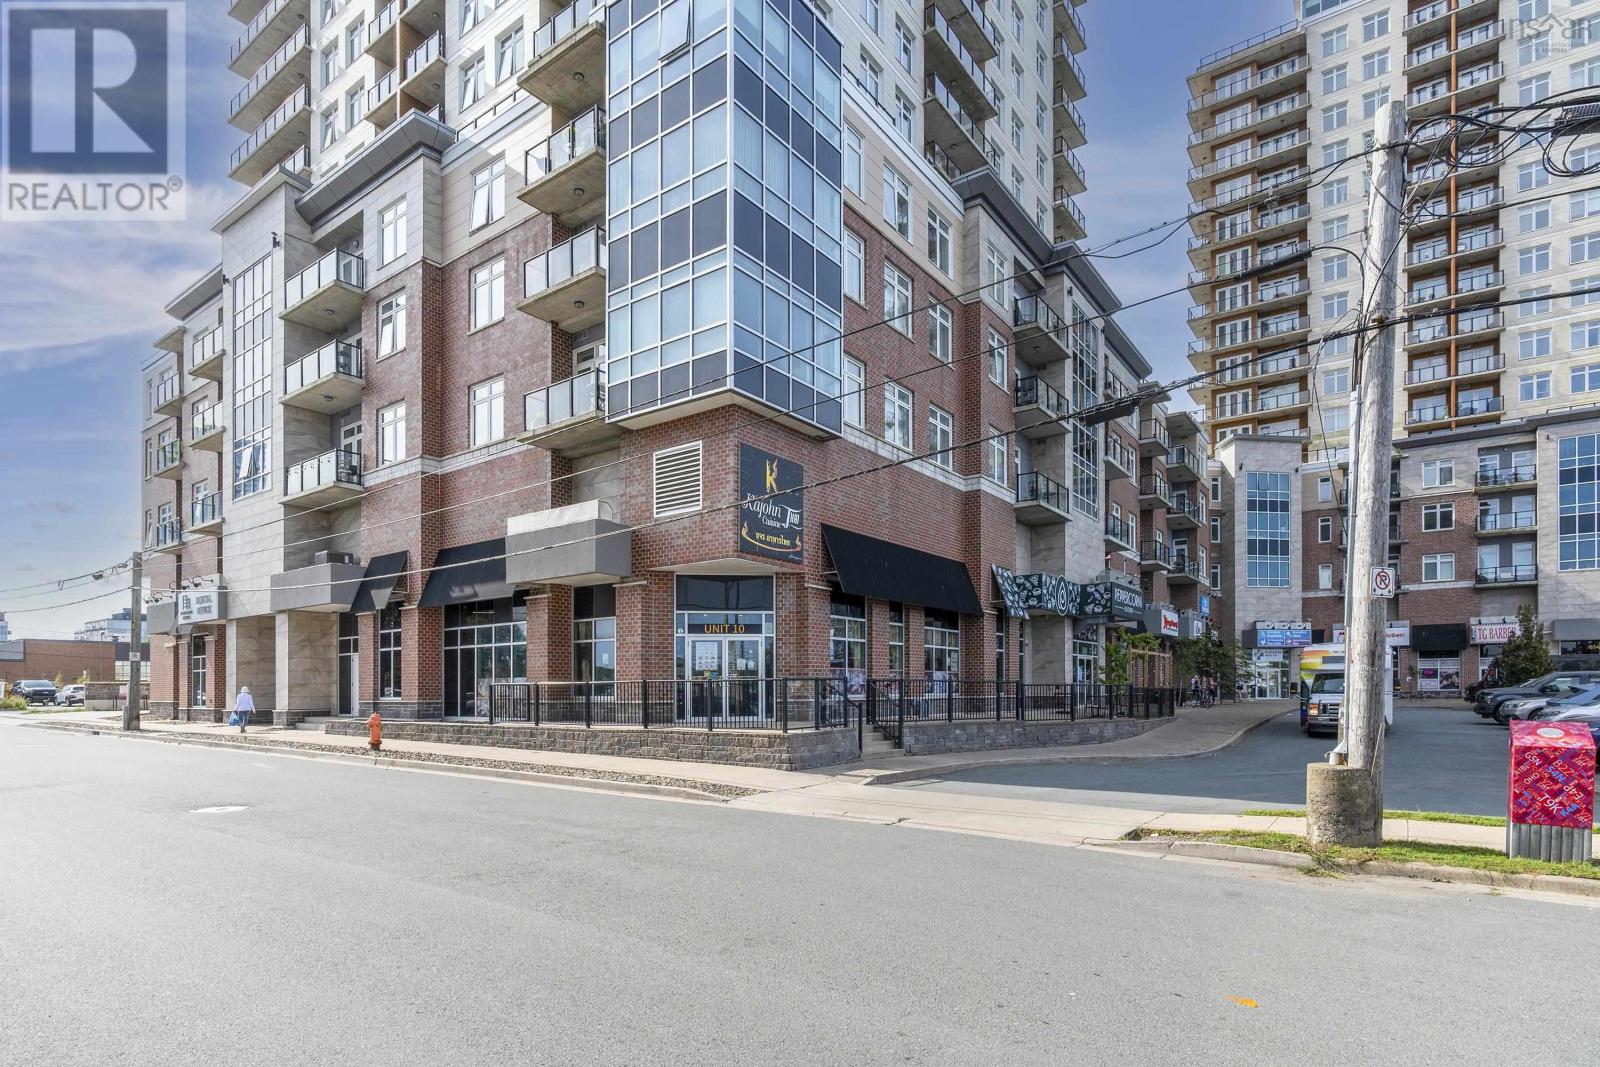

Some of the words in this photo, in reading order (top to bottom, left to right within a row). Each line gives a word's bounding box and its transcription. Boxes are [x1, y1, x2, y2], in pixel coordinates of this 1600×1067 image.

[704, 624, 730, 634] UNIT
[732, 624, 745, 634] 10
[1477, 628, 1488, 640] TG
[1538, 793, 1563, 814] T9K
